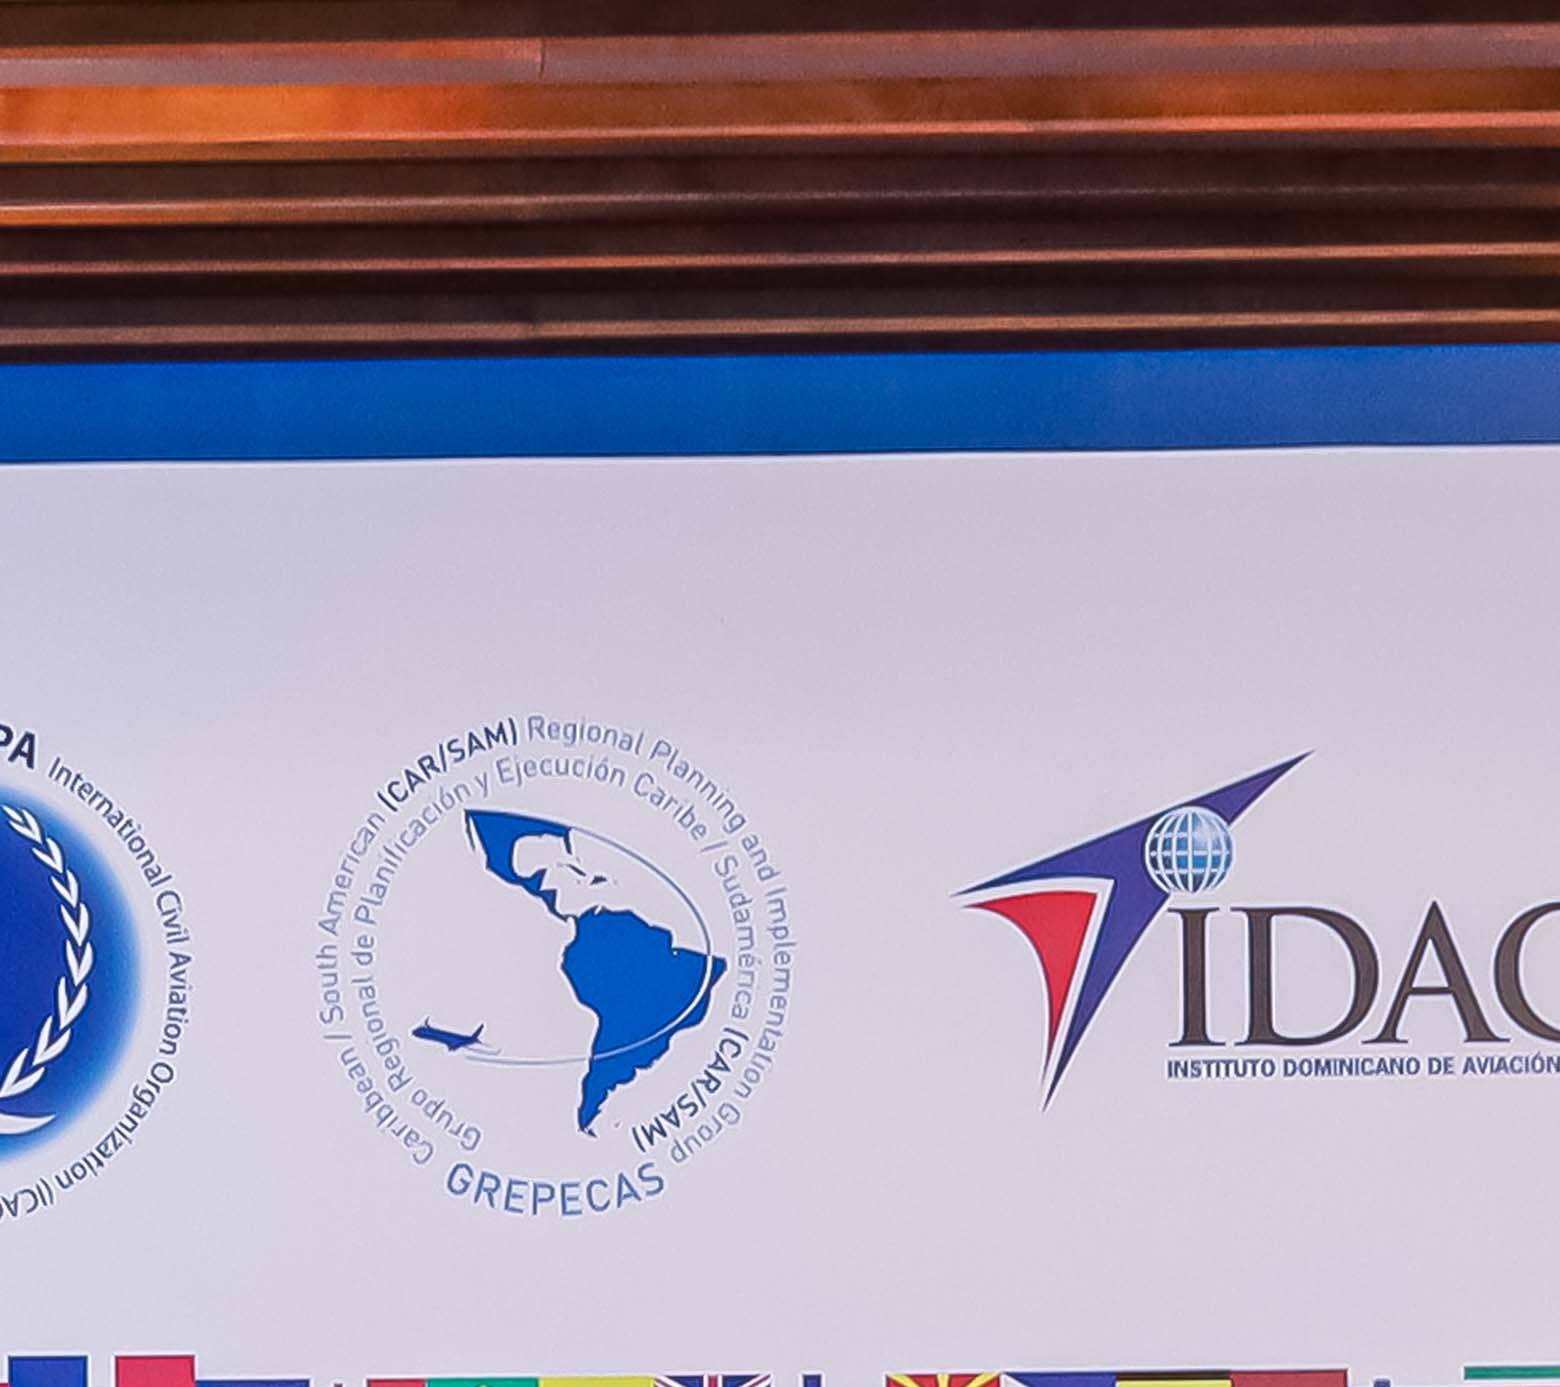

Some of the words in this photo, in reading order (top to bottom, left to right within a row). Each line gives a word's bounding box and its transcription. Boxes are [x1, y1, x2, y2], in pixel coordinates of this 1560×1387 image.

[376, 717, 518, 812] (CAR/SAM)
[495, 755, 627, 790] Ejecución
[527, 715, 643, 756] Regional
[48, 757, 172, 888] International
[471, 772, 489, 802] y
[632, 771, 709, 842] Caribe
[649, 739, 747, 835] Planning
[317, 810, 385, 937] American
[352, 781, 471, 928] Planificación
[742, 831, 780, 884] and
[155, 889, 191, 946] Civil
[351, 935, 376, 968] de
[713, 851, 757, 1021] Sudamérica
[158, 950, 192, 1057] Aviation
[316, 944, 346, 1025] South
[736, 886, 798, 1101] Implementation
[351, 975, 413, 1093] Regional
[1167, 1057, 1277, 1079] INSTITUTO
[1282, 1054, 1421, 1078] DOMINICANO
[1427, 1054, 1455, 1076] DE
[58, 1061, 175, 1190] Organization
[340, 1045, 436, 1166] Caribbean
[410, 1084, 482, 1153] Grupo
[632, 1026, 750, 1153] (CAR/SAM)
[670, 1098, 742, 1165] Group
[446, 1162, 665, 1216] GREPECAS
